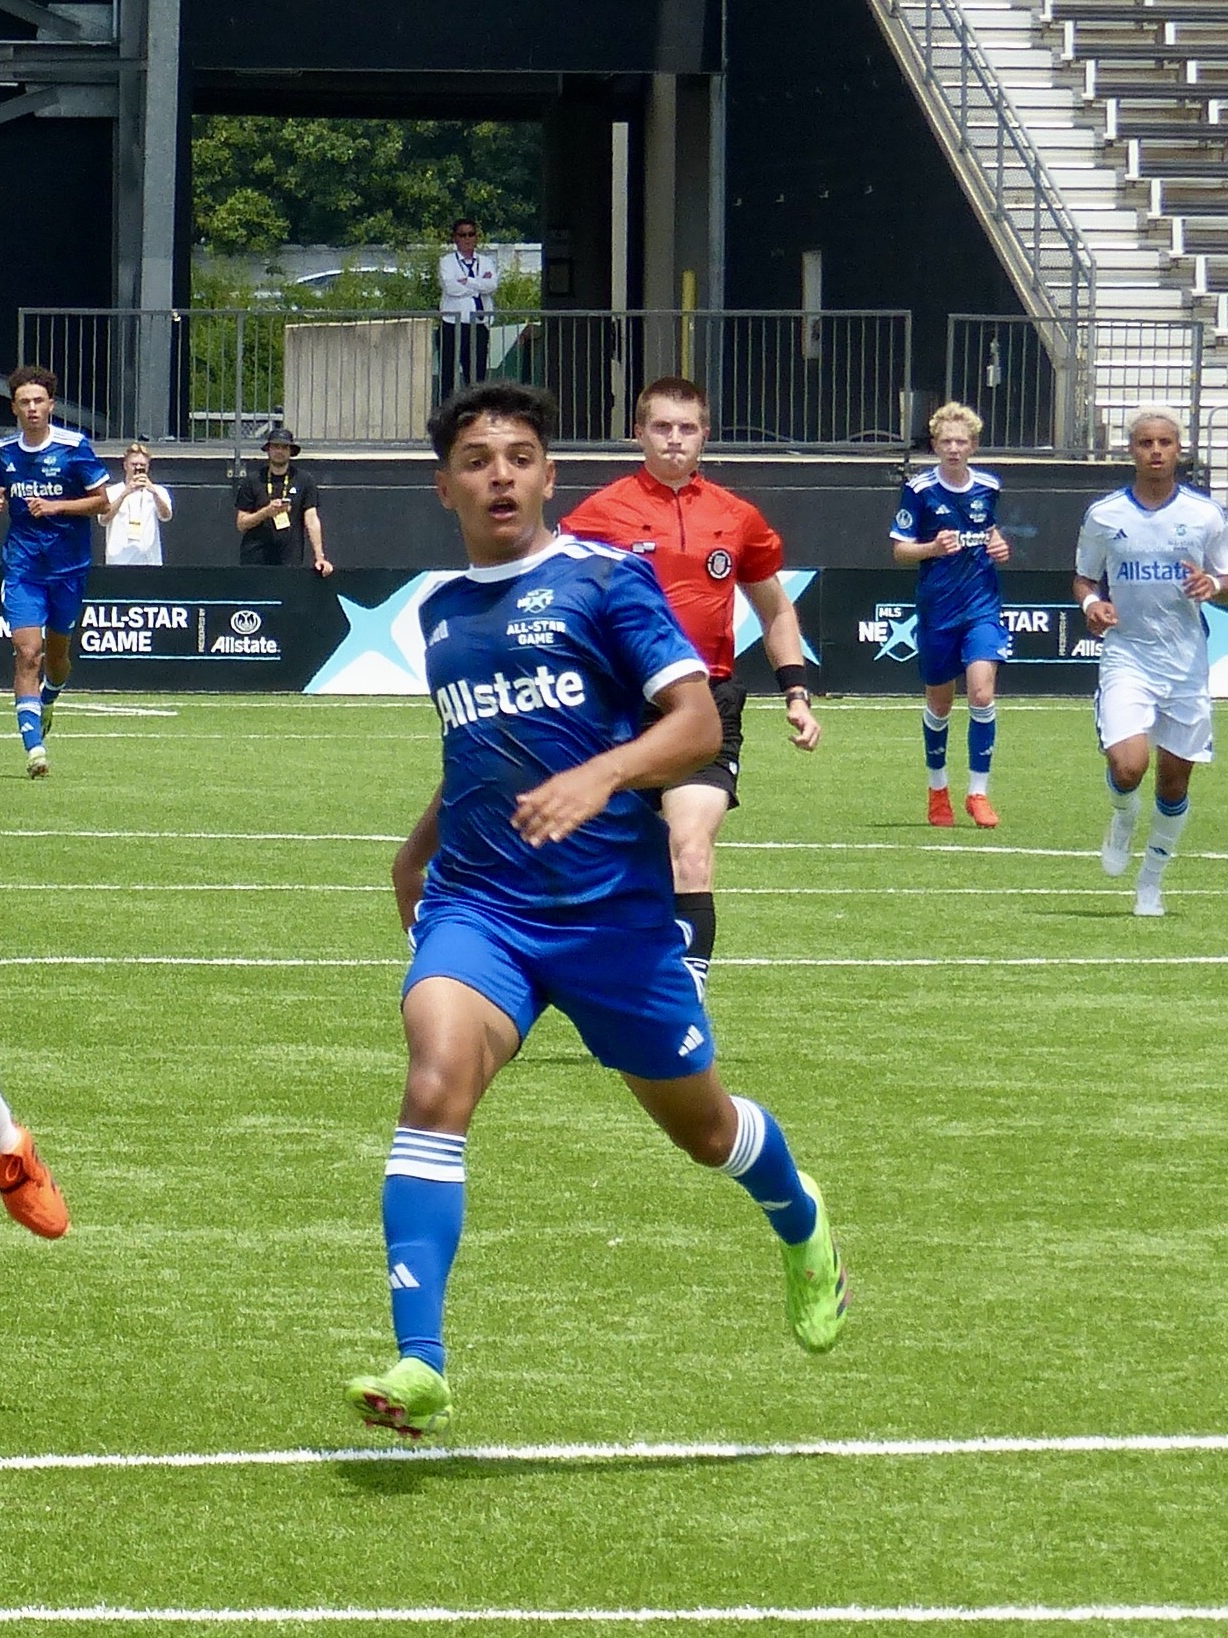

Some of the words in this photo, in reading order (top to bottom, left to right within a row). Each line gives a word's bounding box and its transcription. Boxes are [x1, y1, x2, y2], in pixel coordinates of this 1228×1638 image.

[10, 481, 63, 498] Allstate
[81, 606, 188, 628] ALL-STAR
[879, 607, 902, 618] MLS
[506, 620, 566, 635] ALL-STAR
[81, 631, 152, 652] GAME
[210, 636, 278, 653] Allstate
[518, 633, 554, 645] GAME
[436, 666, 585, 736] Allstate
